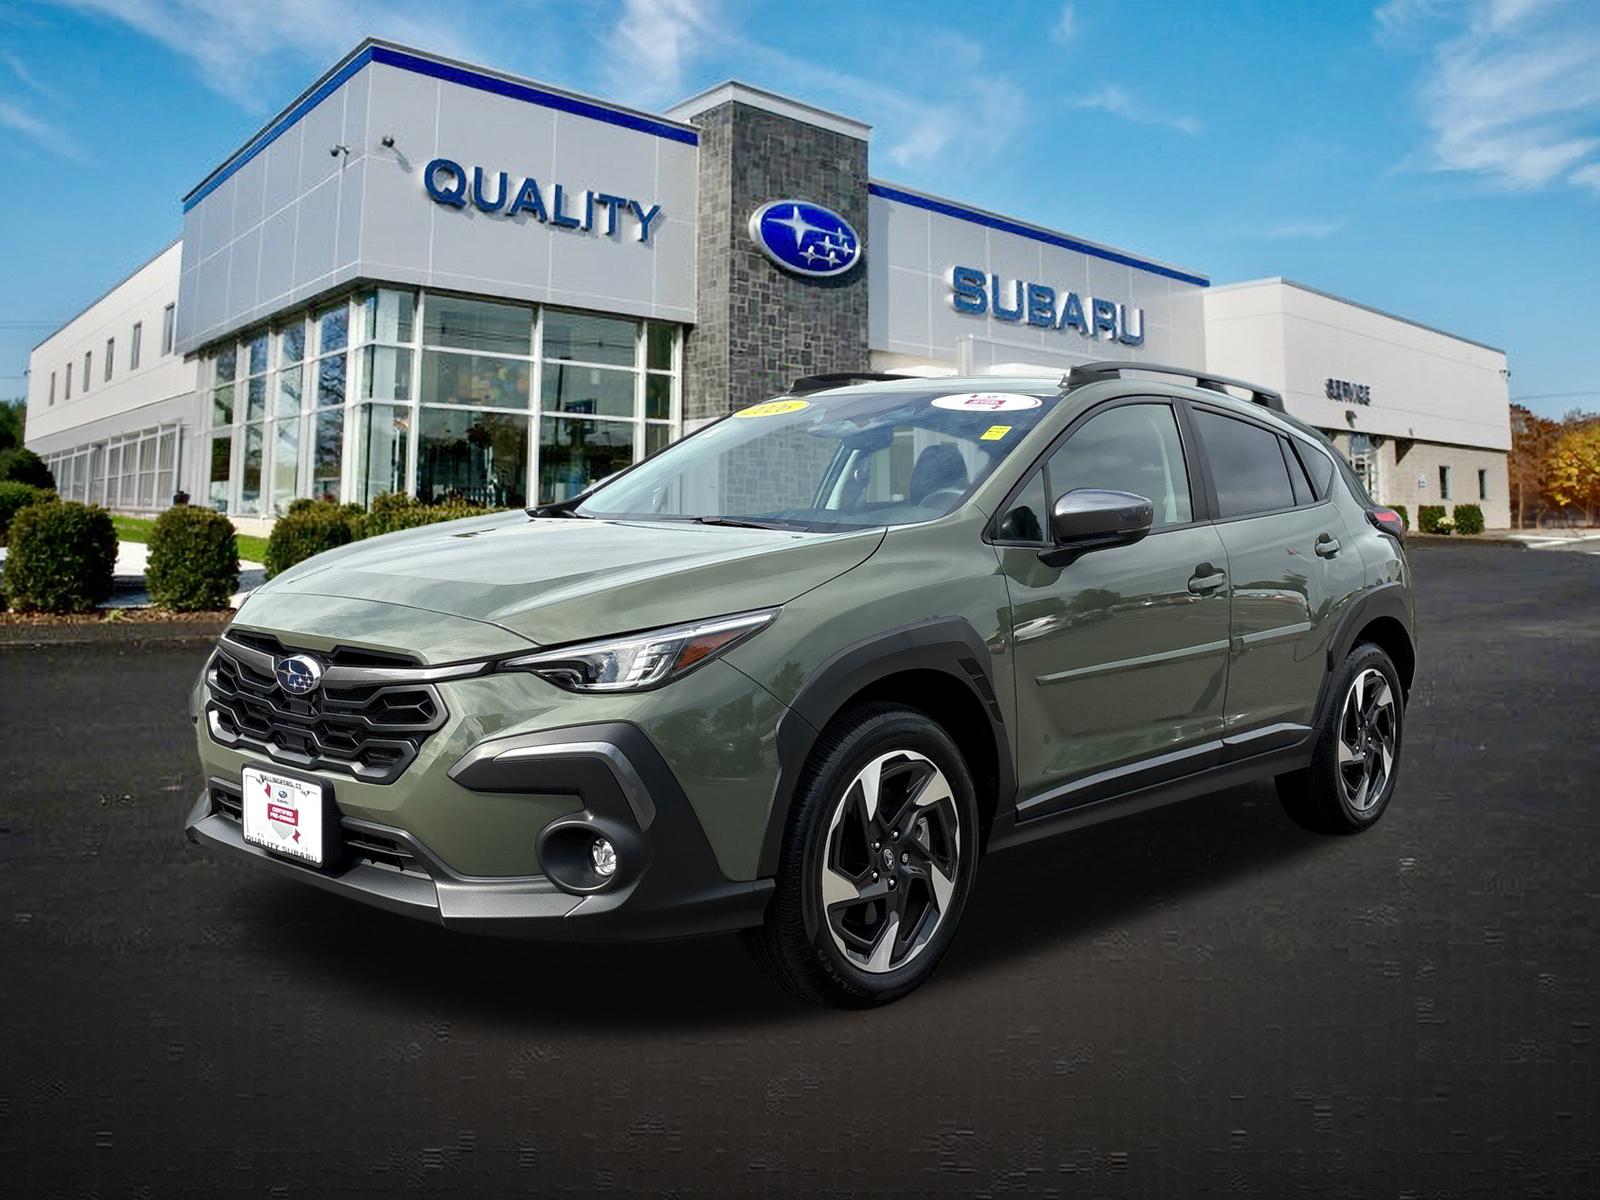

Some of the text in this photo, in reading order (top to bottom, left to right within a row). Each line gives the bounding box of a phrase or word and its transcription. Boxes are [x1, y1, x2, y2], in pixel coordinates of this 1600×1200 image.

[423, 158, 661, 243] QUALITY
[951, 265, 1145, 346] SUBARU
[1325, 378, 1371, 406] SERVICE
